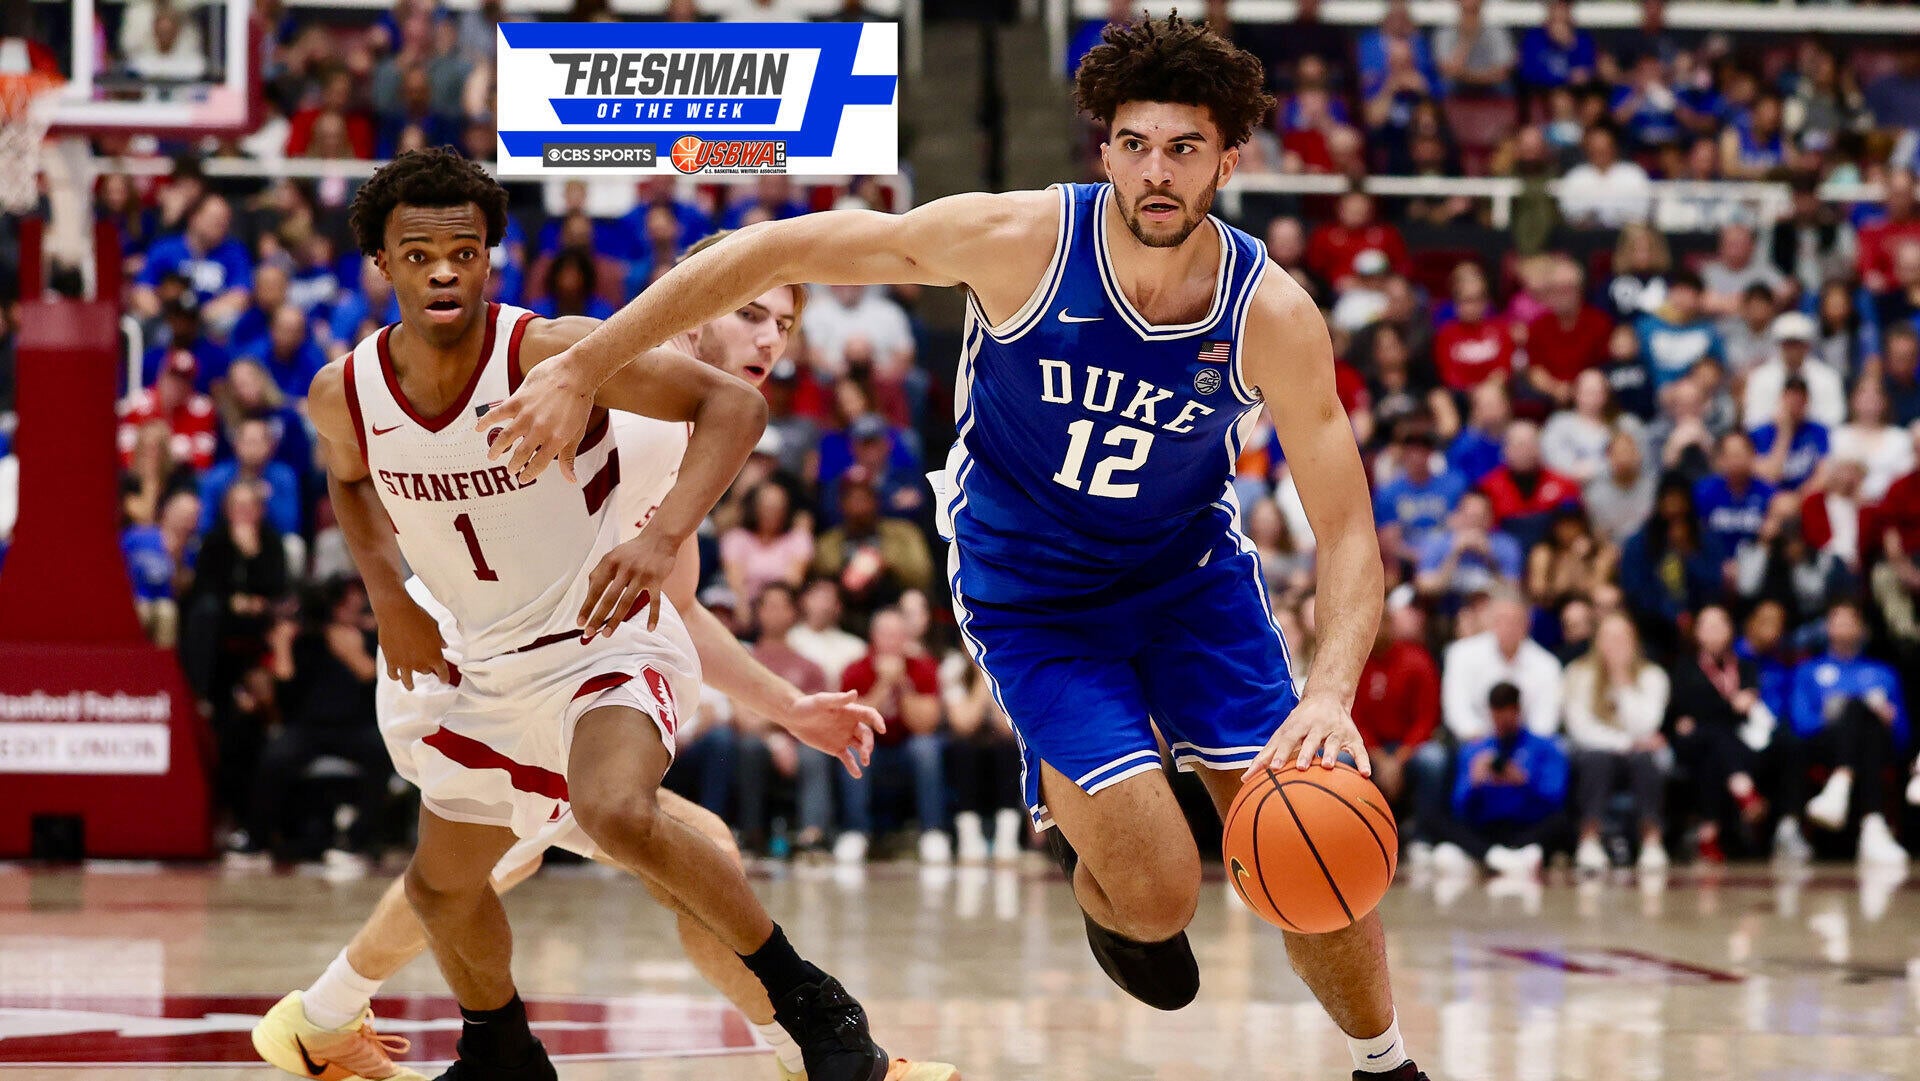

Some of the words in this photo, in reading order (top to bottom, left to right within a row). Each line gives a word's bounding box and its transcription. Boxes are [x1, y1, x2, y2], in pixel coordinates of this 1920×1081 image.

[1038, 358, 1216, 434] DUKE
[1052, 419, 1155, 499] 12
[453, 513, 499, 582] 1
